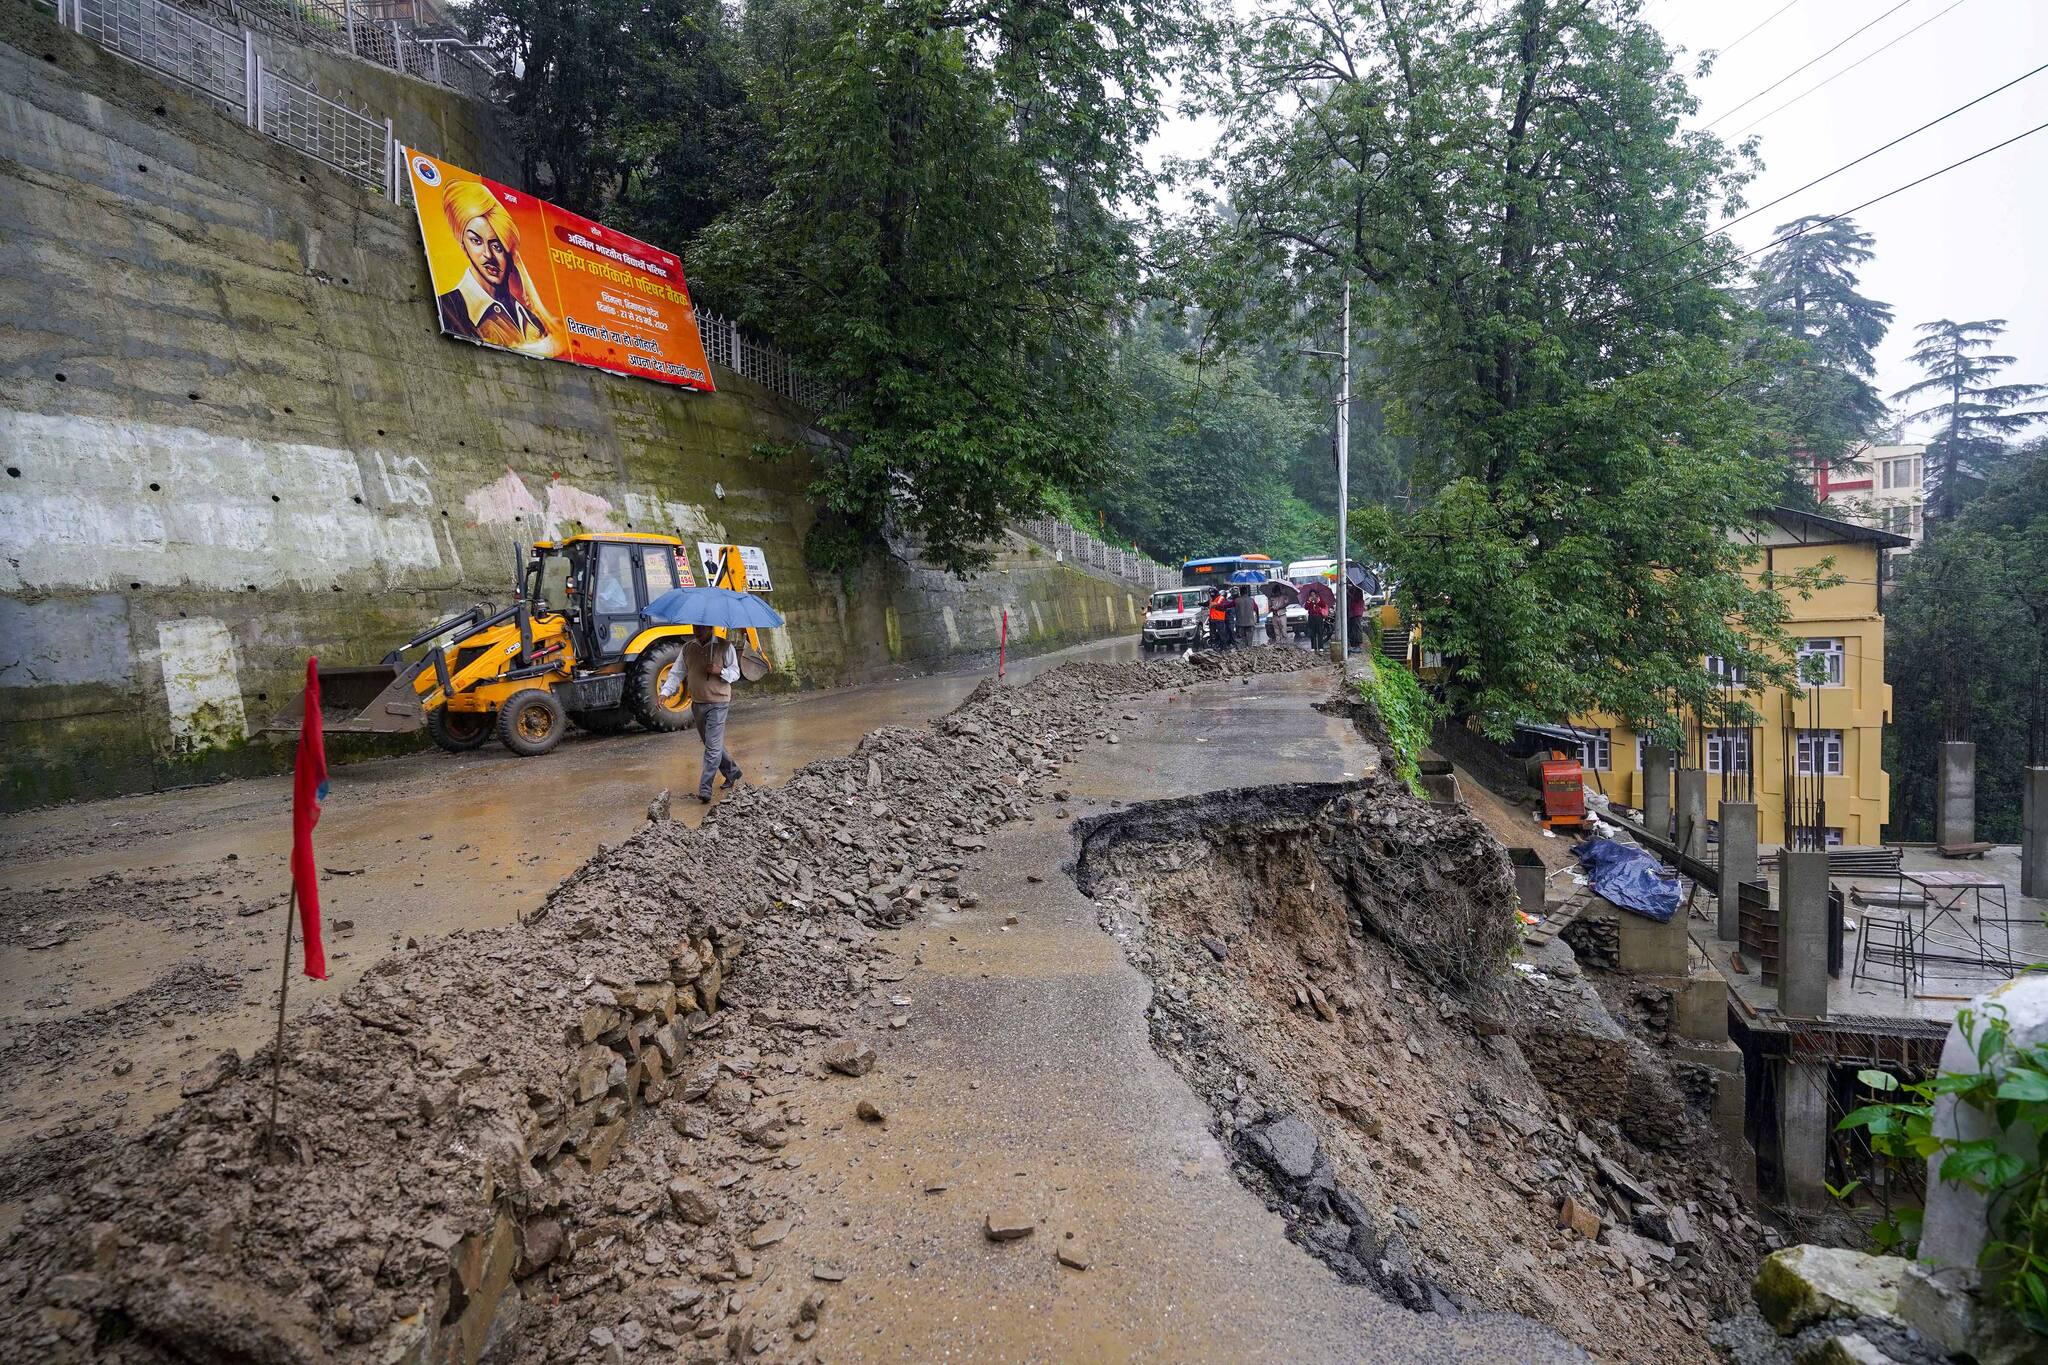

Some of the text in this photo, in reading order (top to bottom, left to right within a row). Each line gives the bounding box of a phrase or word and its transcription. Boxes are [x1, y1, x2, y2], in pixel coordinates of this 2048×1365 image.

[596, 243, 623, 262] भारतीय
[550, 247, 586, 271] राष्ट्रीय
[586, 259, 634, 289] कार्यकारी
[664, 283, 689, 307] बैठक
[566, 316, 600, 339] शिमला
[600, 325, 610, 342] हो
[610, 330, 622, 344] या
[622, 330, 633, 347] हो
[628, 353, 653, 371] अपना
[652, 356, 665, 373] देश
[505, 642, 521, 655] JCB
